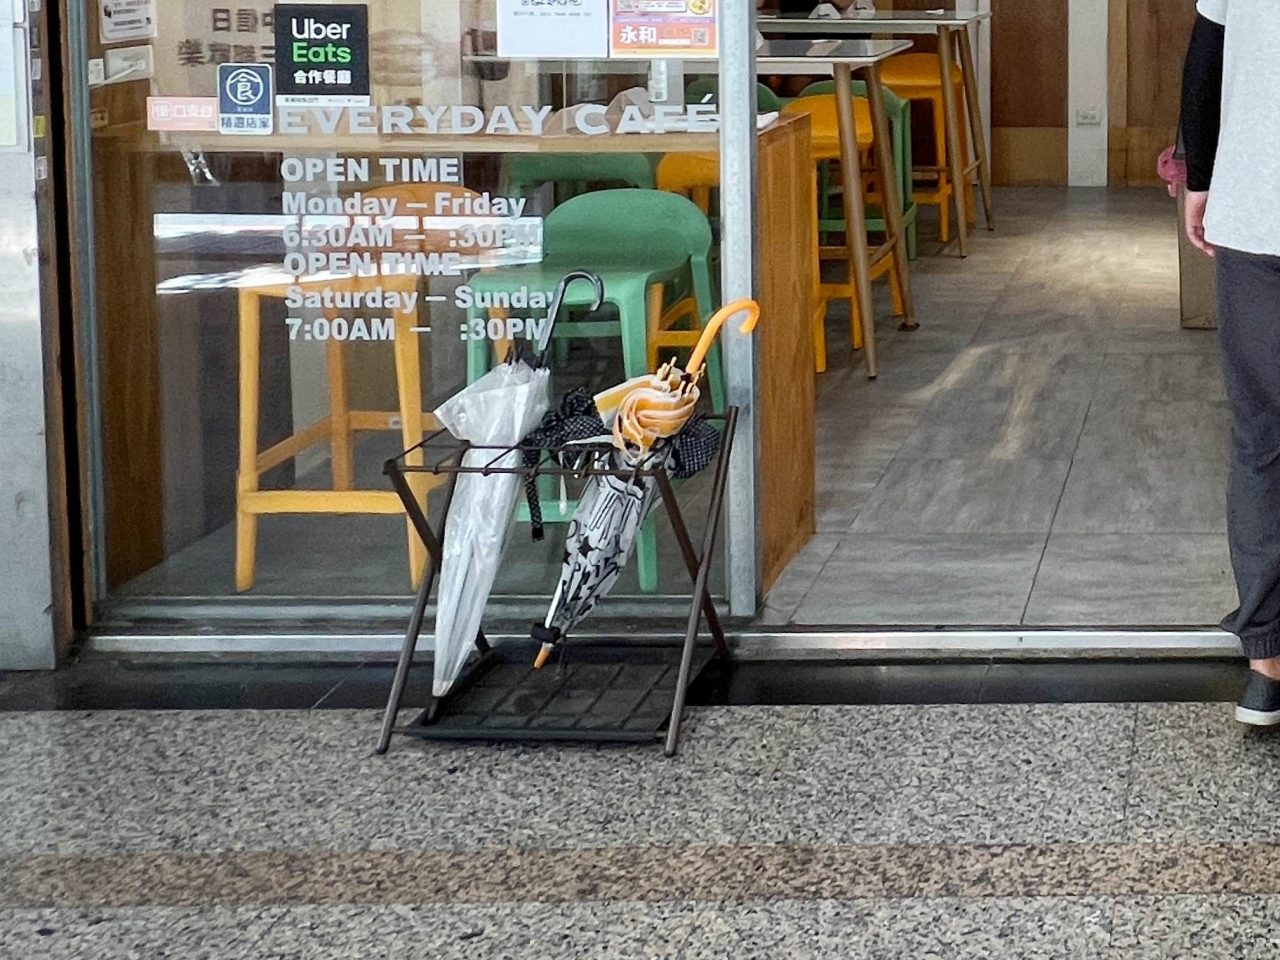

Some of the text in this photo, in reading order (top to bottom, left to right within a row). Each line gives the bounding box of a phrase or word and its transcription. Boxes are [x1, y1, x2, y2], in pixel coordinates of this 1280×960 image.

[291, 17, 351, 40] Uber
[620, 25, 657, 44] 永和
[292, 42, 352, 63] Eats
[279, 93, 722, 135] EVERYDAY CAFÉ
[280, 157, 459, 182] OPEN TIME
[281, 192, 398, 219] Monday
[434, 192, 526, 218] Friday
[283, 224, 393, 247] 6:30AM
[284, 252, 461, 276] OPEN TIME
[285, 286, 418, 313] Saturday
[285, 318, 395, 340] 7:00AM
